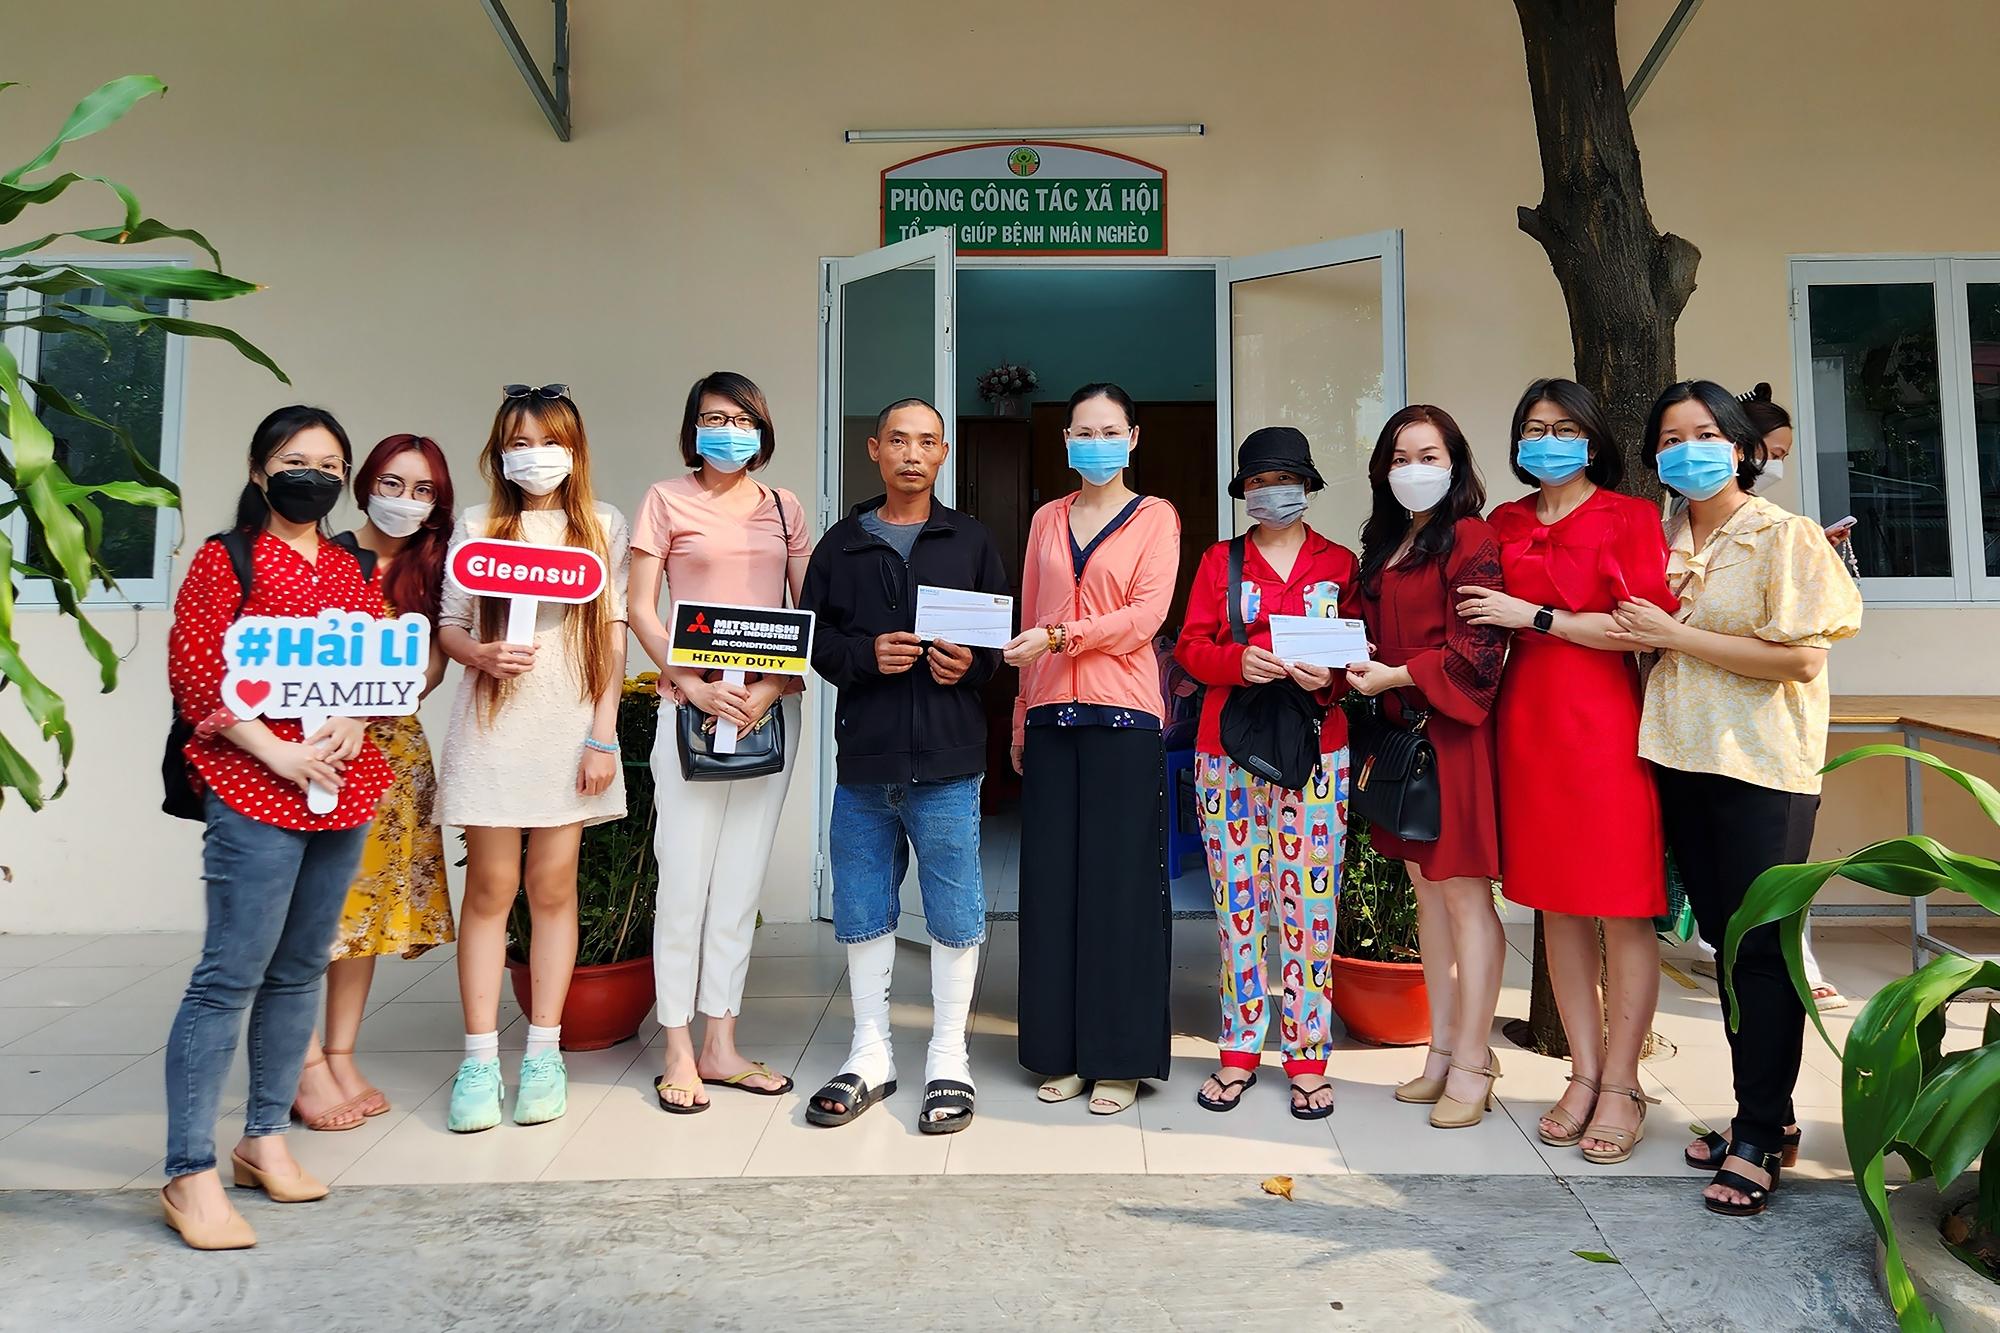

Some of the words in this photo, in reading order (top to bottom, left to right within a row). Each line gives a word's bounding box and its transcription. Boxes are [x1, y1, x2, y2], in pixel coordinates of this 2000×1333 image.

[890, 182, 964, 212] PHÒNG
[970, 182, 1029, 212] CÔNG
[1035, 182, 1079, 212] TÁC
[1085, 182, 1113, 212] XÃ
[1121, 182, 1159, 216] HỘI
[898, 216, 921, 241] TỔ
[961, 222, 998, 243] GIÚP
[1002, 221, 1044, 246] BỆNH
[1050, 221, 1093, 243] NHÂN
[1097, 221, 1149, 243] NGHÈO
[466, 555, 586, 586] Cleansui
[712, 628, 742, 636] HEAVY
[743, 630, 799, 640] INDUSTRIES
[713, 619, 800, 635] MITSUBISHI
[235, 617, 364, 667] #Hải
[380, 622, 419, 667] Li
[711, 639, 729, 647] AIR
[729, 641, 798, 652] CONDITIONERS
[692, 653, 740, 665] HEAVY
[745, 657, 786, 668] DUTY
[281, 681, 416, 708] FAMILY
[830, 1082, 863, 1104] FIRMLY
